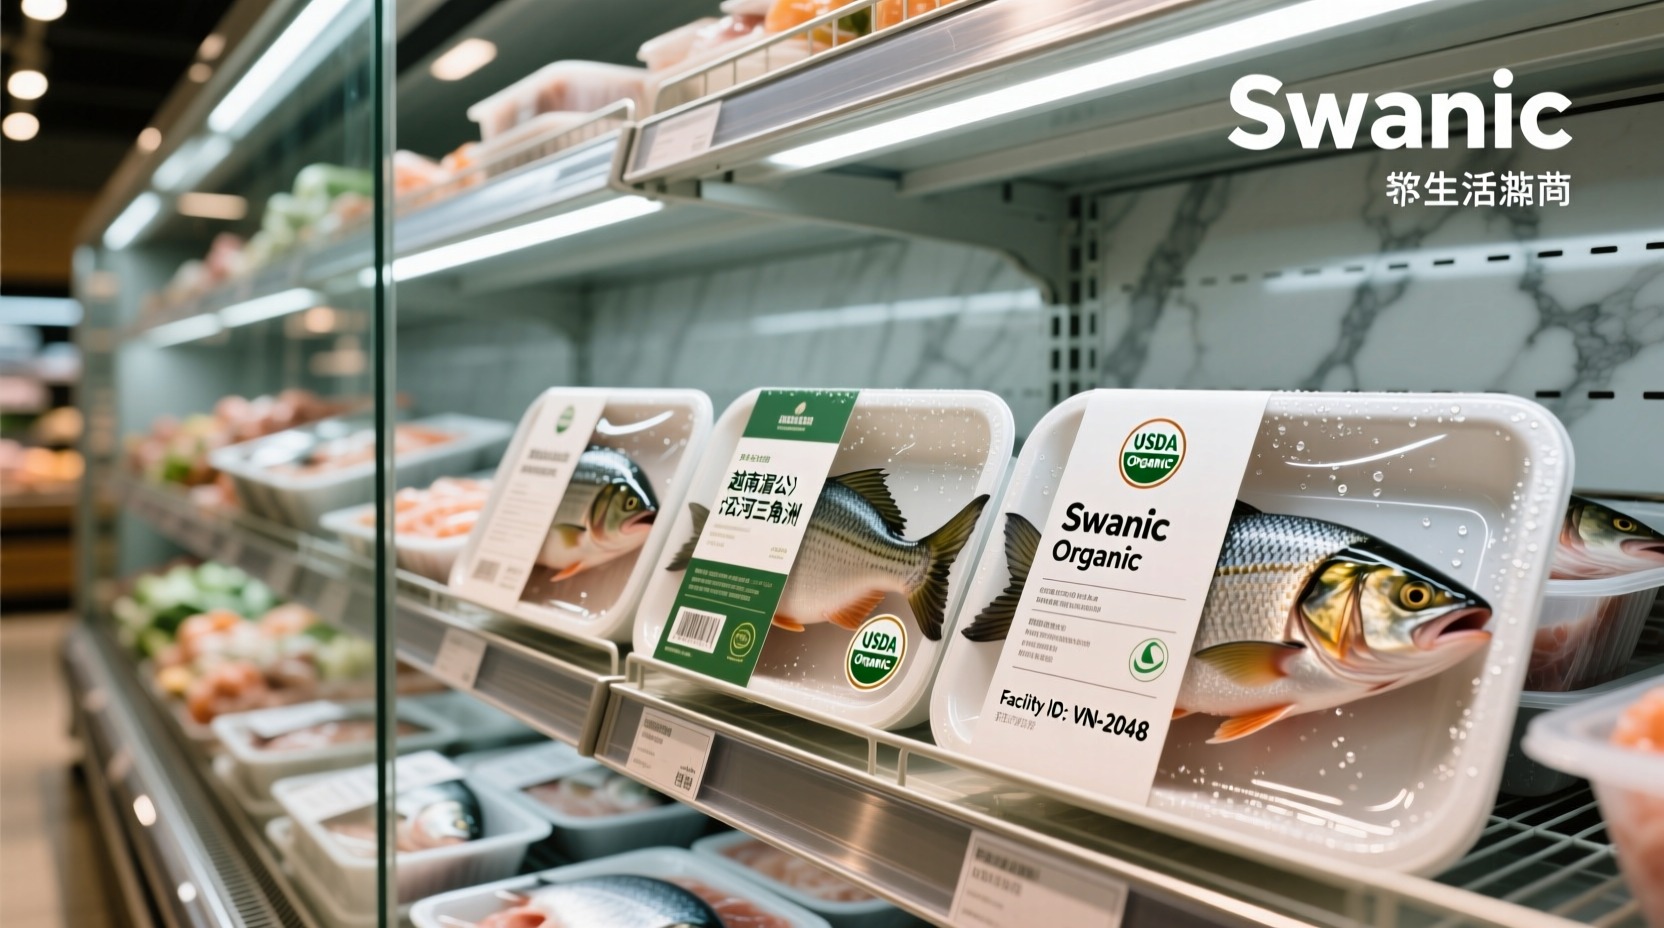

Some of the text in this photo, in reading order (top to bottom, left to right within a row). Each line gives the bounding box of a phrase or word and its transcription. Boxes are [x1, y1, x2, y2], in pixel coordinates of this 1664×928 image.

[1134, 432, 1178, 452] USDA
[1061, 502, 1170, 541] Swanic
[1052, 539, 1143, 572] Organic
[862, 631, 897, 654] USDA
[1046, 698, 1069, 722] ID:
[1074, 704, 1150, 742] VN-2048
